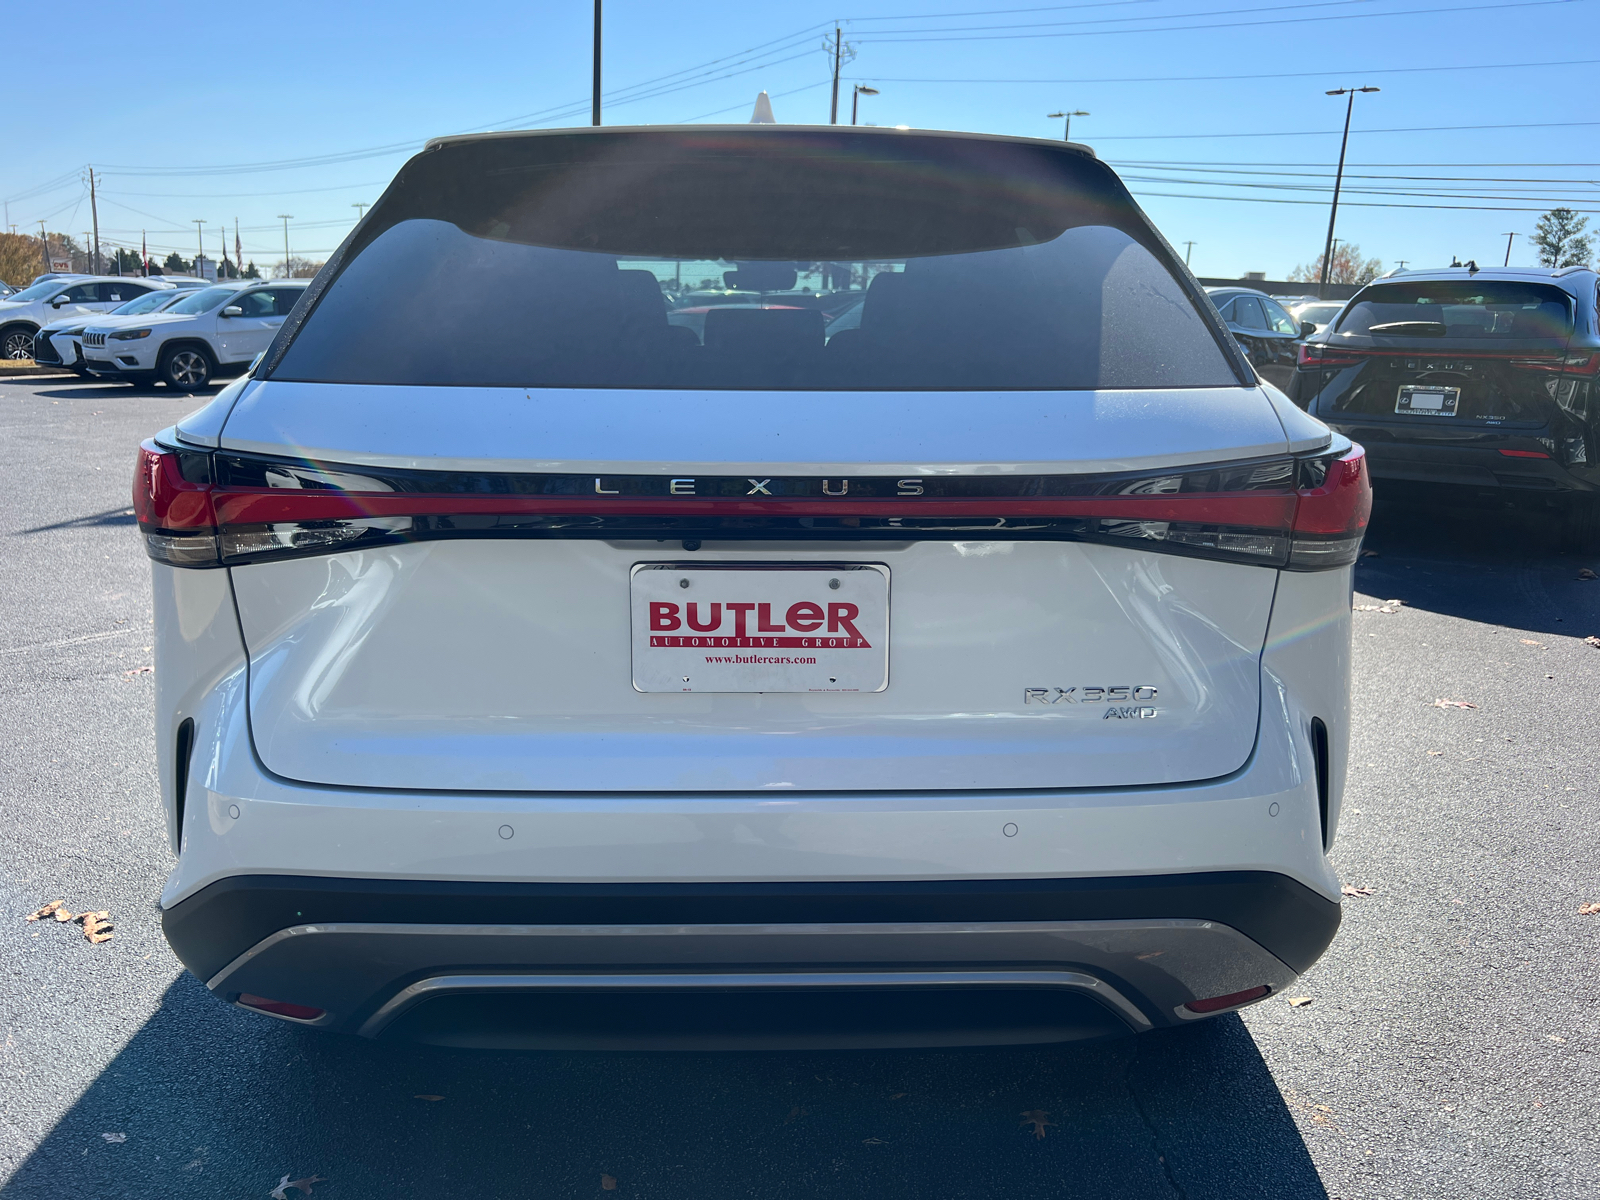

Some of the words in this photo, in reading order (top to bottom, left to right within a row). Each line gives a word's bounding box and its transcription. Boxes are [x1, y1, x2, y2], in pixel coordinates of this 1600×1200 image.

[1390, 362, 1473, 370] LEXUS
[595, 478, 924, 496] LEXUS
[651, 637, 779, 647] AUTOMOTIVE
[801, 638, 863, 648] GROUP
[705, 654, 816, 664] www.butlercars.com
[1024, 685, 1158, 705] RX350
[1103, 706, 1158, 719] AWD
